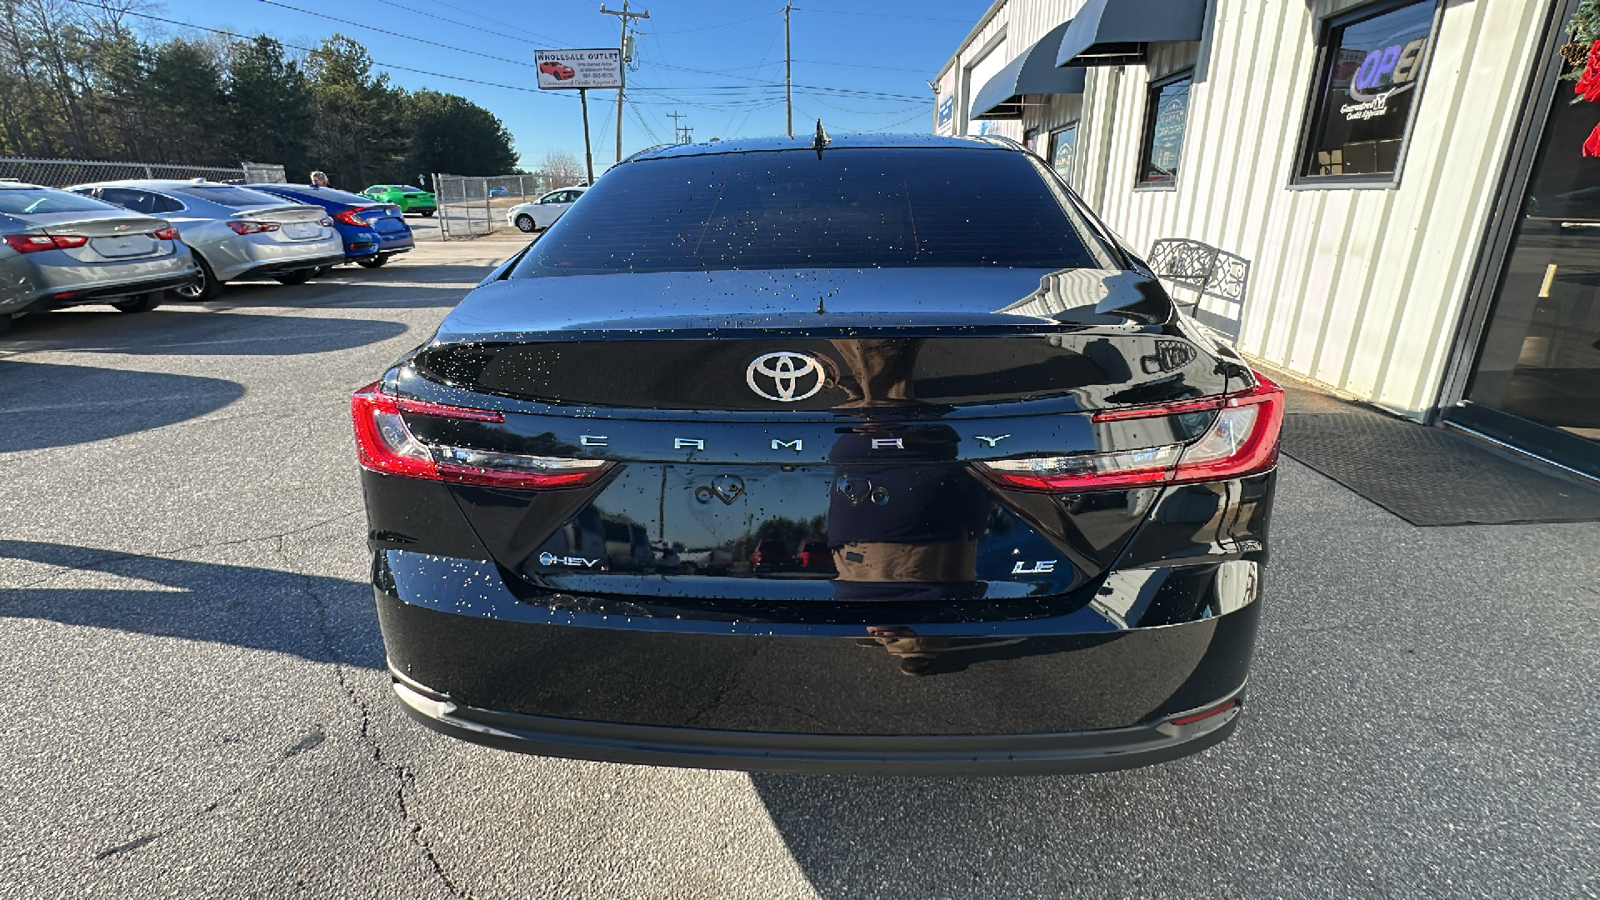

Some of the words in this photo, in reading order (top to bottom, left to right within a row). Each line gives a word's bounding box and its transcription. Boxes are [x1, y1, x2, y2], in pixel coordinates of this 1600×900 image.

[588, 52, 619, 60] OUTLET
[579, 434, 1011, 450] CAMRY
[552, 556, 601, 568] HEV
[1011, 558, 1058, 574] LE
